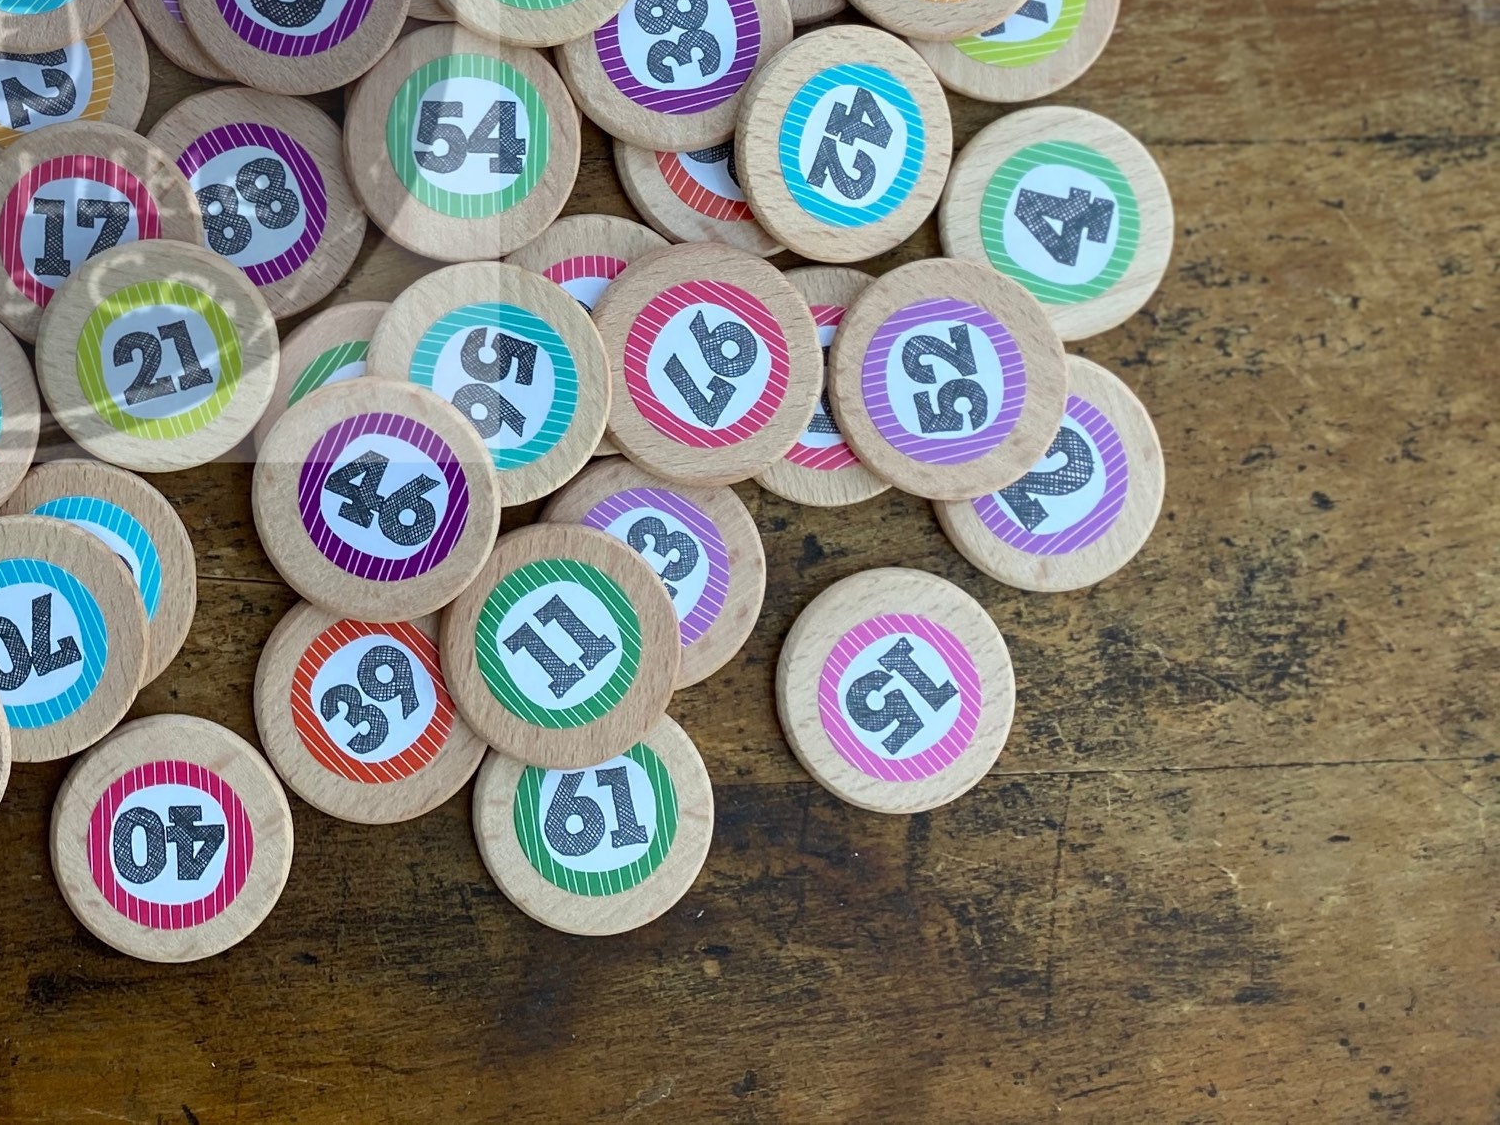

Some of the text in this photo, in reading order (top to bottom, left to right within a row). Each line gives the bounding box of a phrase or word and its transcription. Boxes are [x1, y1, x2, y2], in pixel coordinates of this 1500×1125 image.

[409, 101, 534, 185] 54
[809, 92, 893, 202] 42
[34, 198, 131, 281] 17
[197, 157, 302, 258] 88
[1015, 190, 1116, 267] 4
[113, 320, 215, 407] 21
[454, 328, 539, 438] 56
[664, 313, 759, 428] 97
[902, 327, 989, 435] 52
[323, 448, 442, 548] 46
[626, 515, 701, 597] 3
[500, 594, 617, 701] 11
[846, 638, 959, 756] 15
[321, 646, 421, 756] 39
[113, 806, 227, 886] 40
[544, 767, 650, 858] 61
